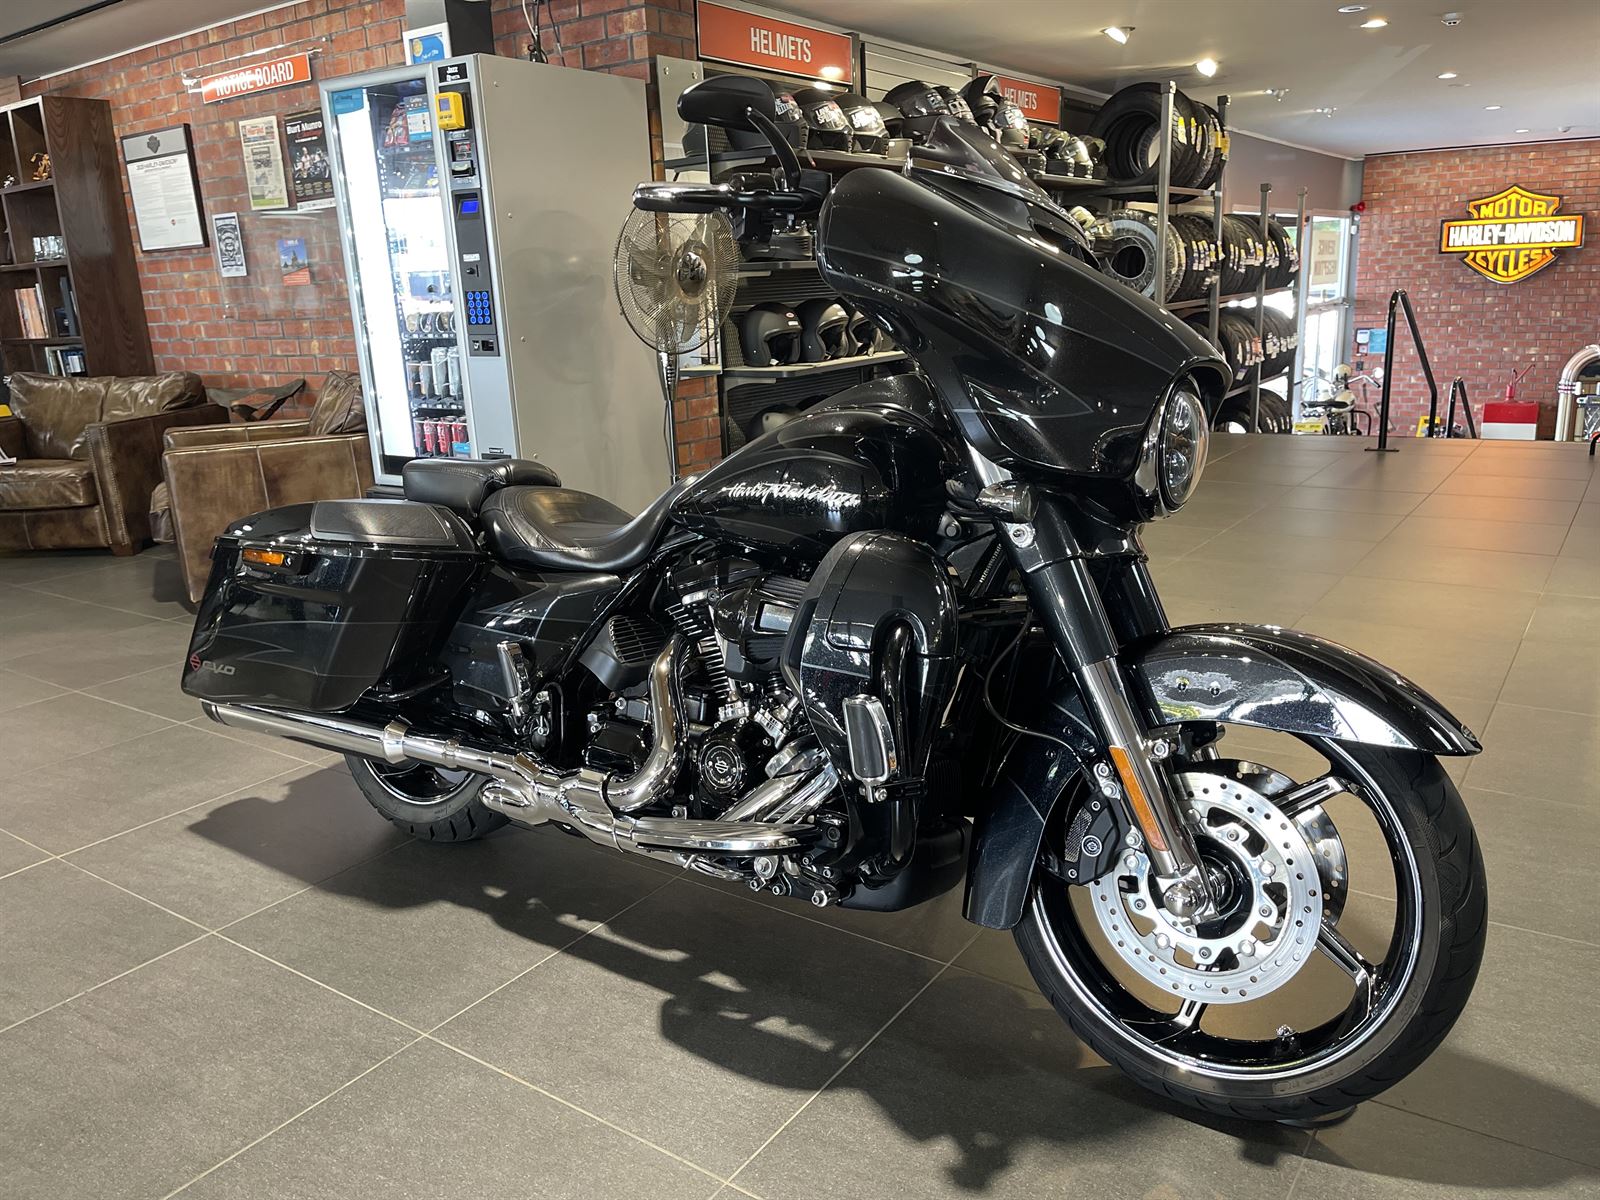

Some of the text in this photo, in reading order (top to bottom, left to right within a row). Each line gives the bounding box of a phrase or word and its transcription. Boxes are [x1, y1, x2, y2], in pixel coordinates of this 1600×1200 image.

[750, 27, 812, 63] HELMETS
[215, 61, 294, 97] NOTICE BOARD
[1004, 87, 1038, 111] HELMETS
[1479, 192, 1547, 218] MOTOR
[1448, 220, 1576, 247] HARLEY-DAVIDSON
[1475, 249, 1544, 277] CYCLES
[202, 660, 236, 675] CVO
